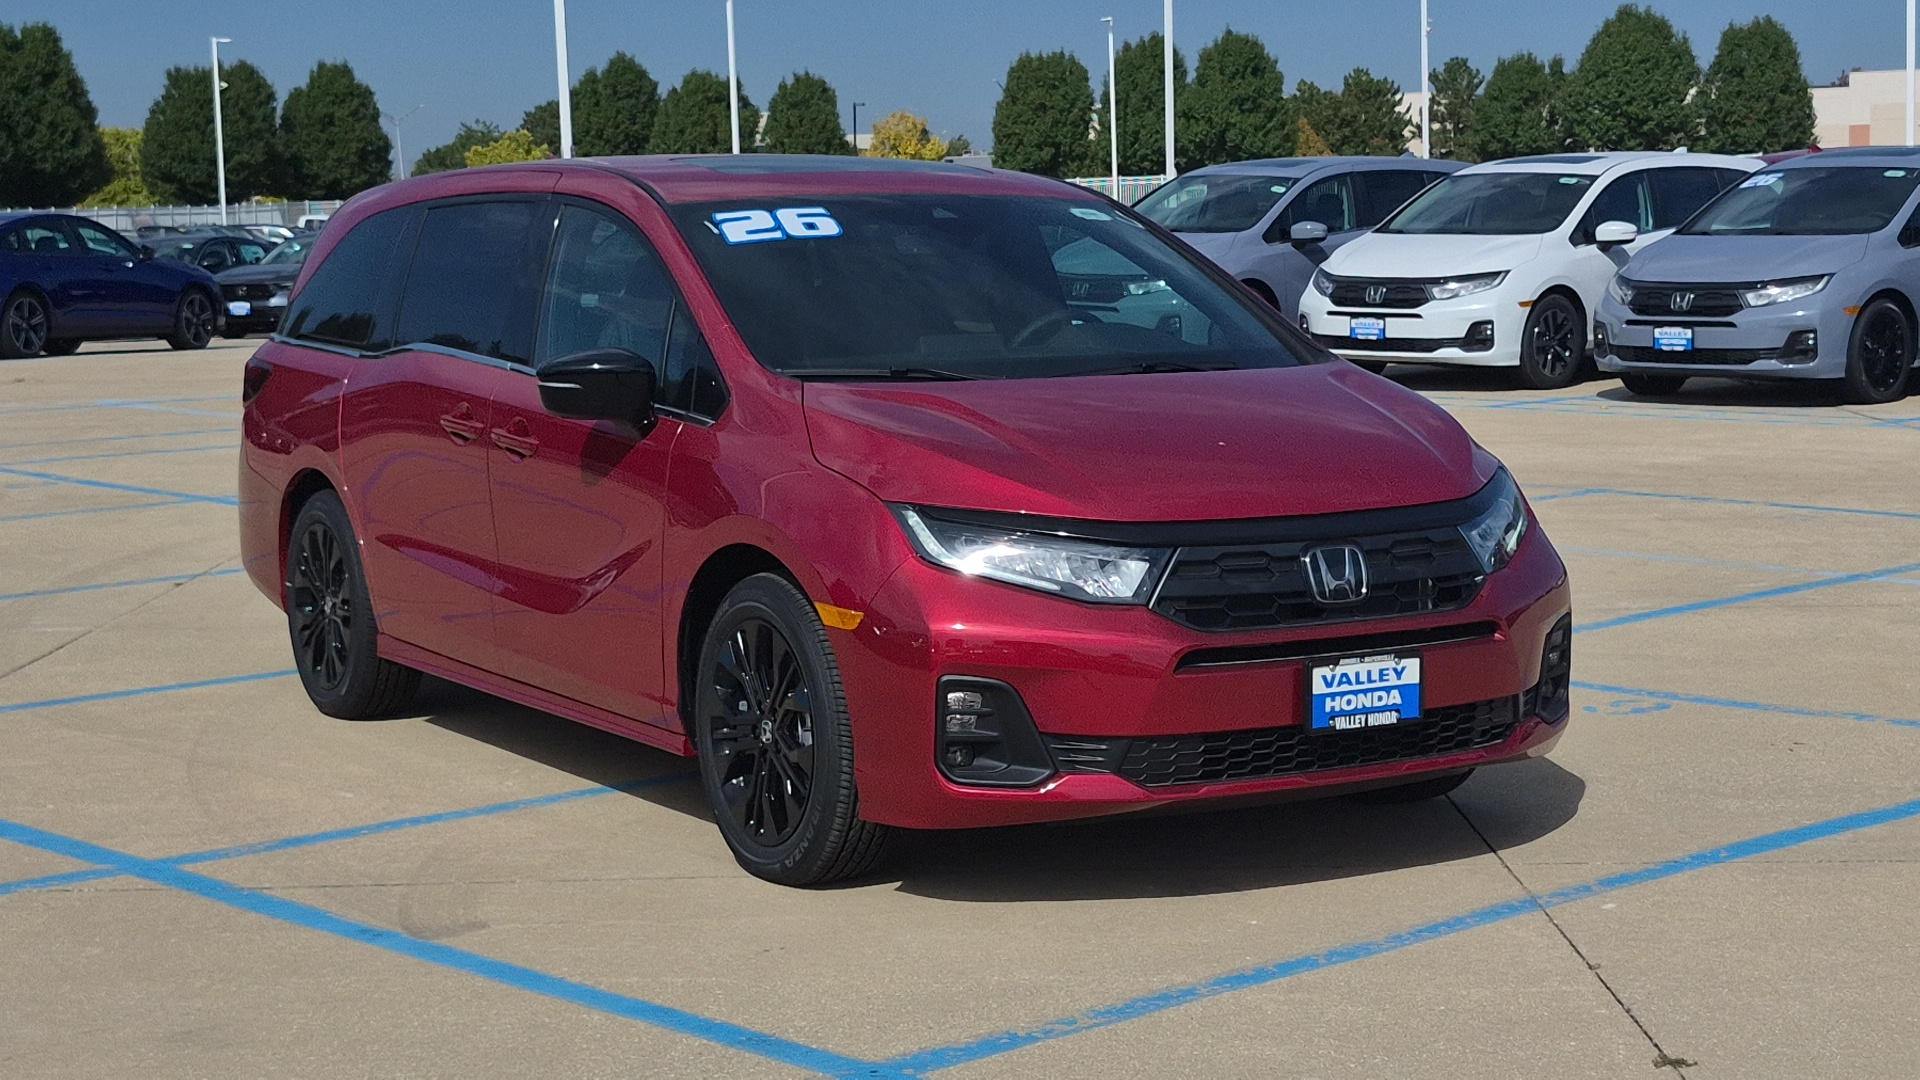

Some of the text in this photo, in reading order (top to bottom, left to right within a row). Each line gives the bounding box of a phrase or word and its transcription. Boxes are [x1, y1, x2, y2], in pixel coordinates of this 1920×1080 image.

[712, 206, 843, 245] 26
[1320, 665, 1407, 689] VALLEY
[1325, 689, 1402, 713] HONDA
[1335, 711, 1398, 730] VALLEY HONDA
